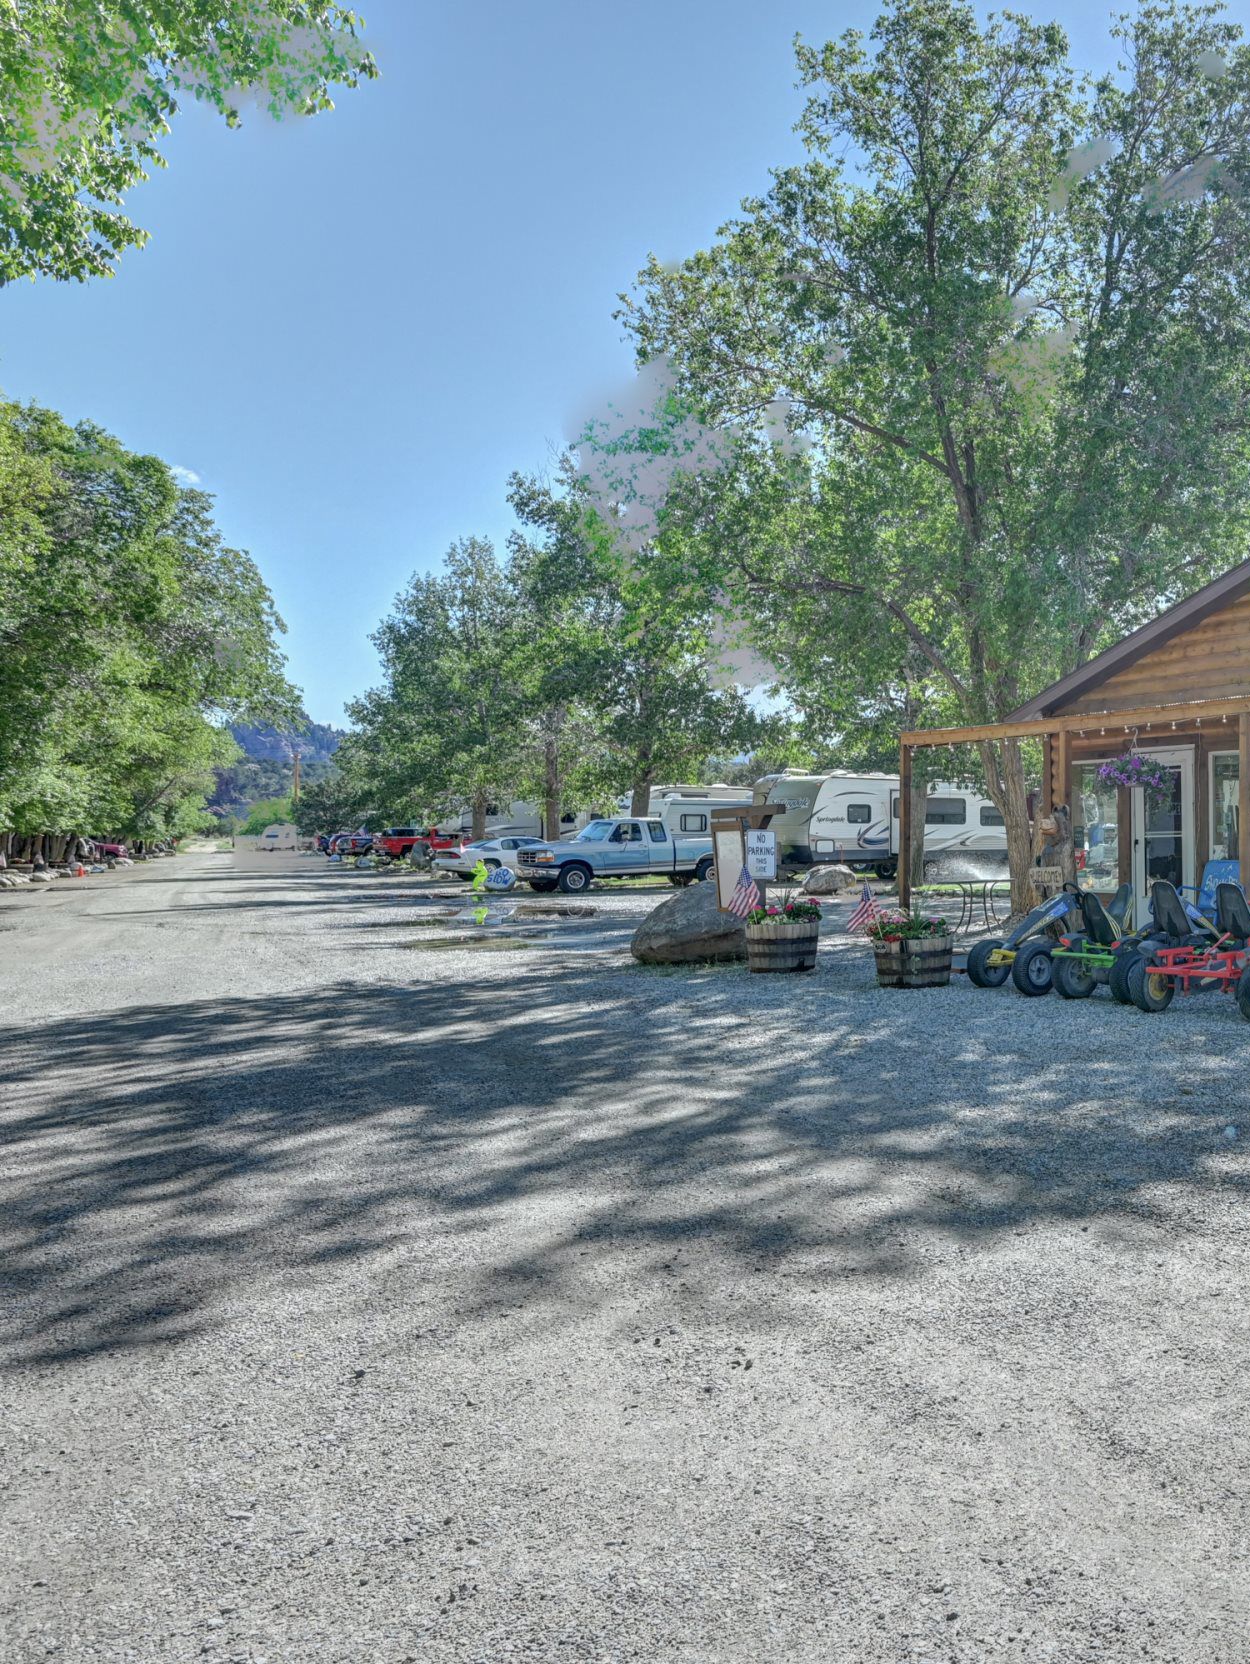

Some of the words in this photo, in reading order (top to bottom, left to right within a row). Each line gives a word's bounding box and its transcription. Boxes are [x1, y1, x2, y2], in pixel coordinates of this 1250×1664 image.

[816, 815, 845, 823] Springdale
[756, 834, 766, 843] NO
[747, 846, 775, 855] PARKING
